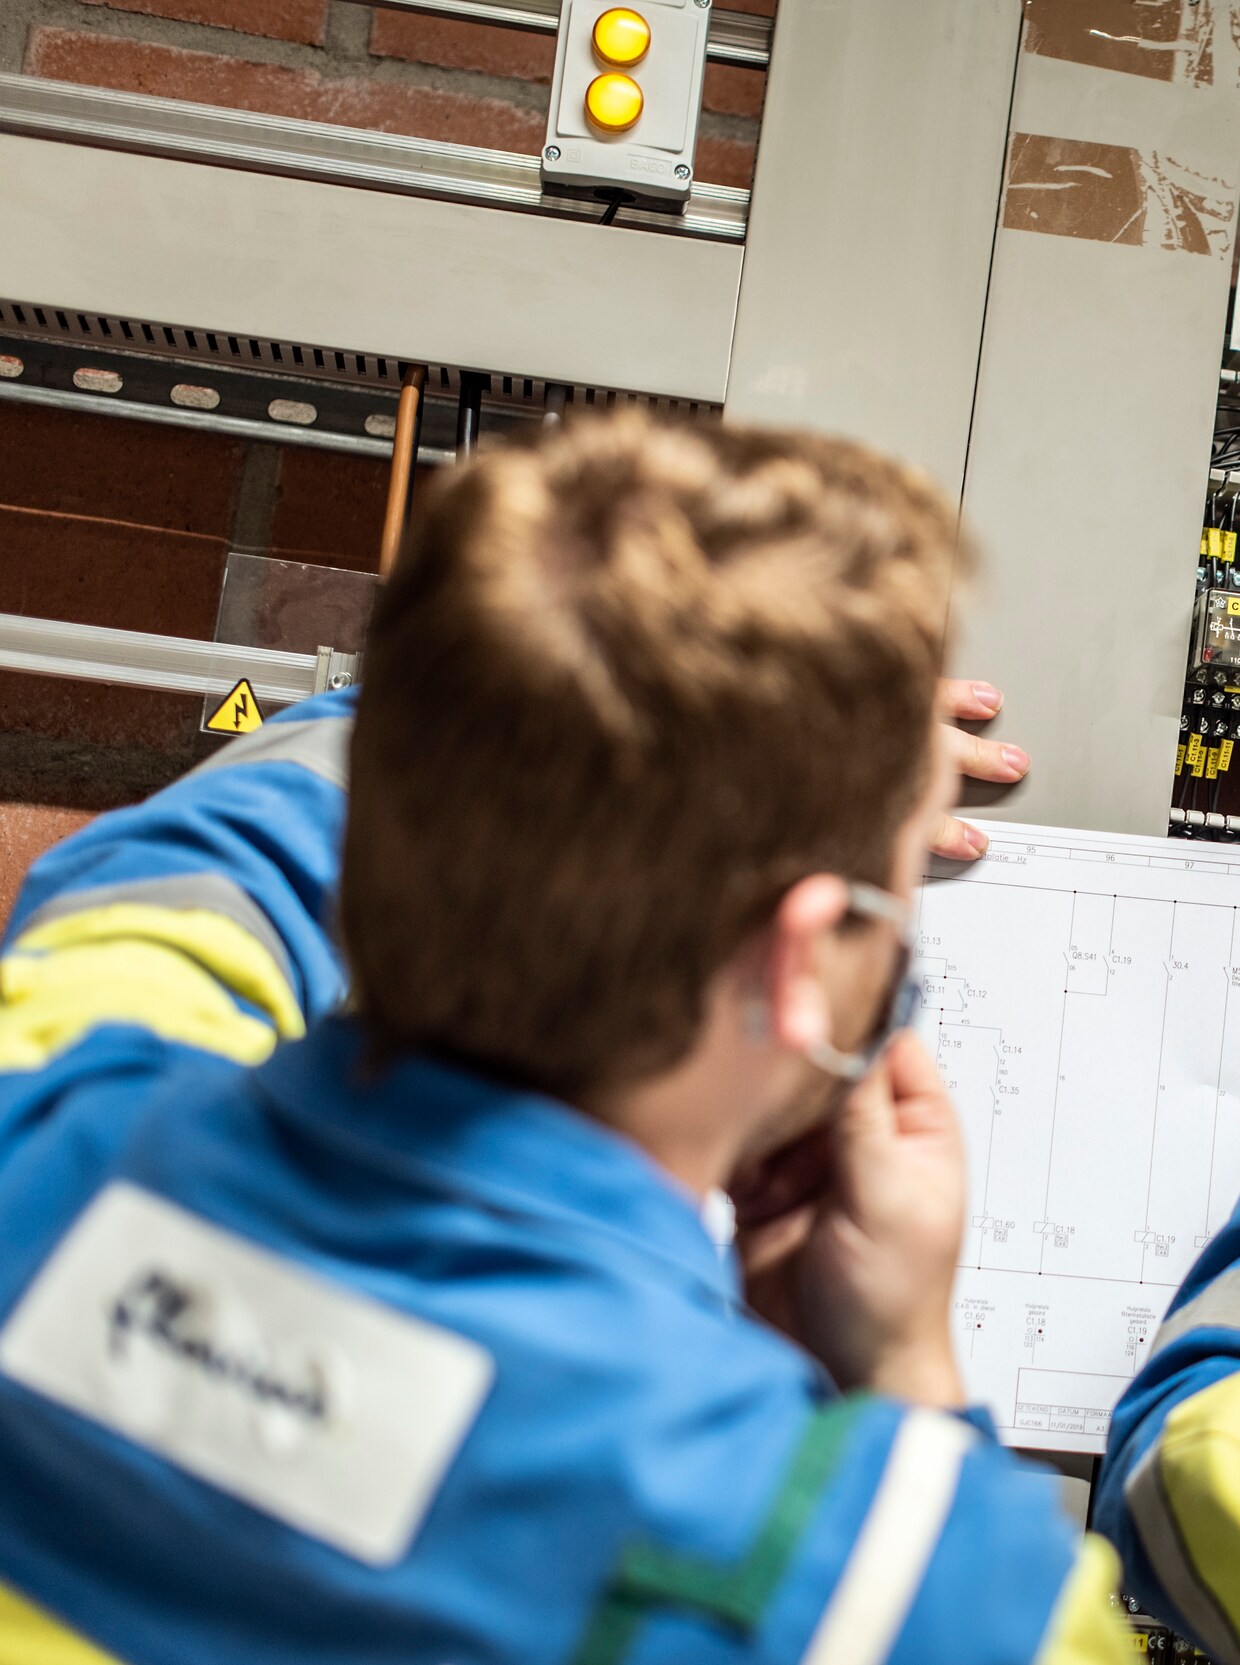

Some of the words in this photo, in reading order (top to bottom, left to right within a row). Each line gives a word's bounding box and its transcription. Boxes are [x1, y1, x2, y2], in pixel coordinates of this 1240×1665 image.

[1190, 738, 1199, 761] C1.11-3
[1221, 742, 1231, 768] C1.11-11
[921, 936, 941, 945] C1.13
[1072, 952, 1096, 960] Q8.S41
[1112, 956, 1132, 964] C1.19
[1173, 961, 1188, 970] 30.4
[927, 985, 945, 993] C1.11
[968, 989, 987, 998] C1.12
[942, 1040, 961, 1048] C1.18
[999, 1086, 1019, 1095] C1.35
[995, 1220, 1015, 1229] C1.60
[1056, 1225, 1075, 1234] C1.18
[1157, 1235, 1175, 1244] C1.19
[1026, 1318, 1045, 1326] C1.18
[1128, 1326, 1147, 1335] C1.19
[1149, 1636, 1165, 1649] CE
